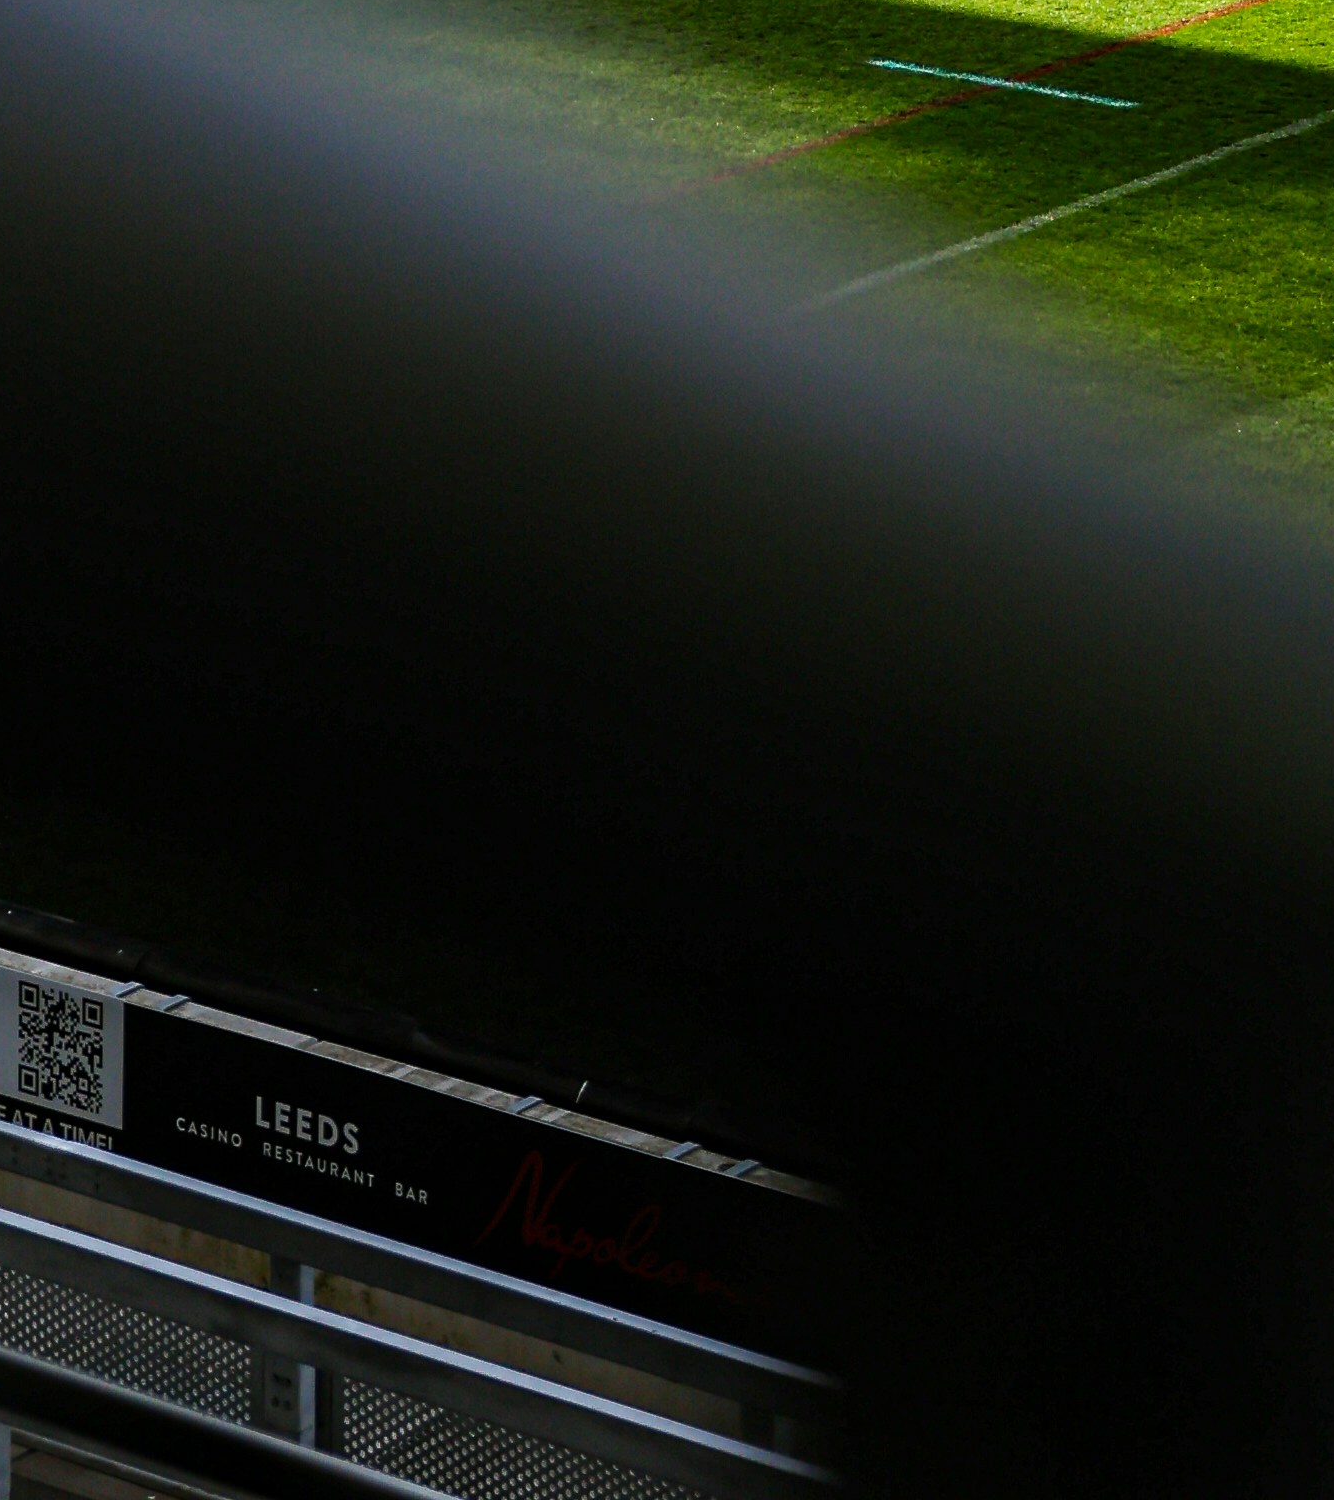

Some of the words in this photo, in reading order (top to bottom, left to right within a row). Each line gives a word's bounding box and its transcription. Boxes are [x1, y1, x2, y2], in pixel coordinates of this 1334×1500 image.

[175, 1116, 244, 1149] CASINO
[261, 1140, 375, 1189] RESTAURANT
[394, 1181, 429, 1206] BAR
[254, 1095, 361, 1157] LEEDS
[475, 1148, 752, 1308] Napoleon
